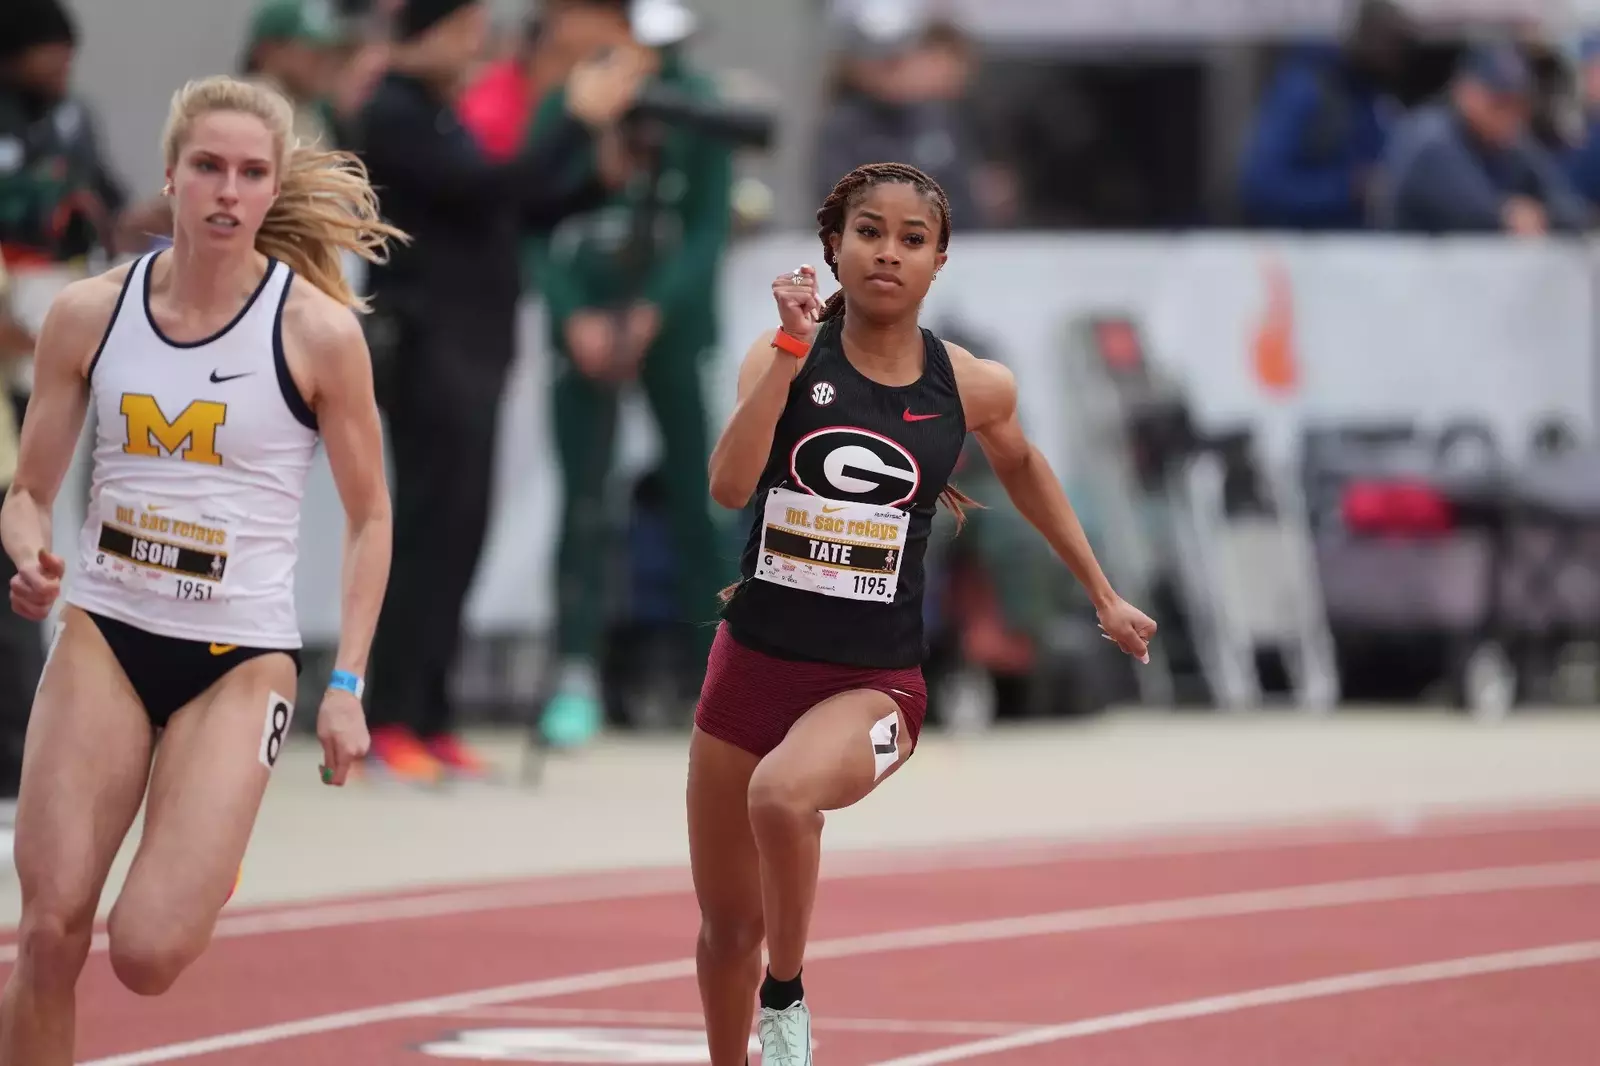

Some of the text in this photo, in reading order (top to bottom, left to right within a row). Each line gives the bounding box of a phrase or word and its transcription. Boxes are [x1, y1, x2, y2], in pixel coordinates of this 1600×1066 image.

[812, 382, 835, 405] SEC
[120, 392, 227, 466] M
[823, 445, 915, 493] G
[814, 514, 846, 533] sac
[847, 518, 899, 540] relays
[131, 538, 180, 568] ISOM
[764, 555, 773, 566] G
[809, 540, 852, 564] TATE
[176, 579, 213, 600] 1951
[853, 576, 887, 596] 1195
[267, 702, 288, 766] 8
